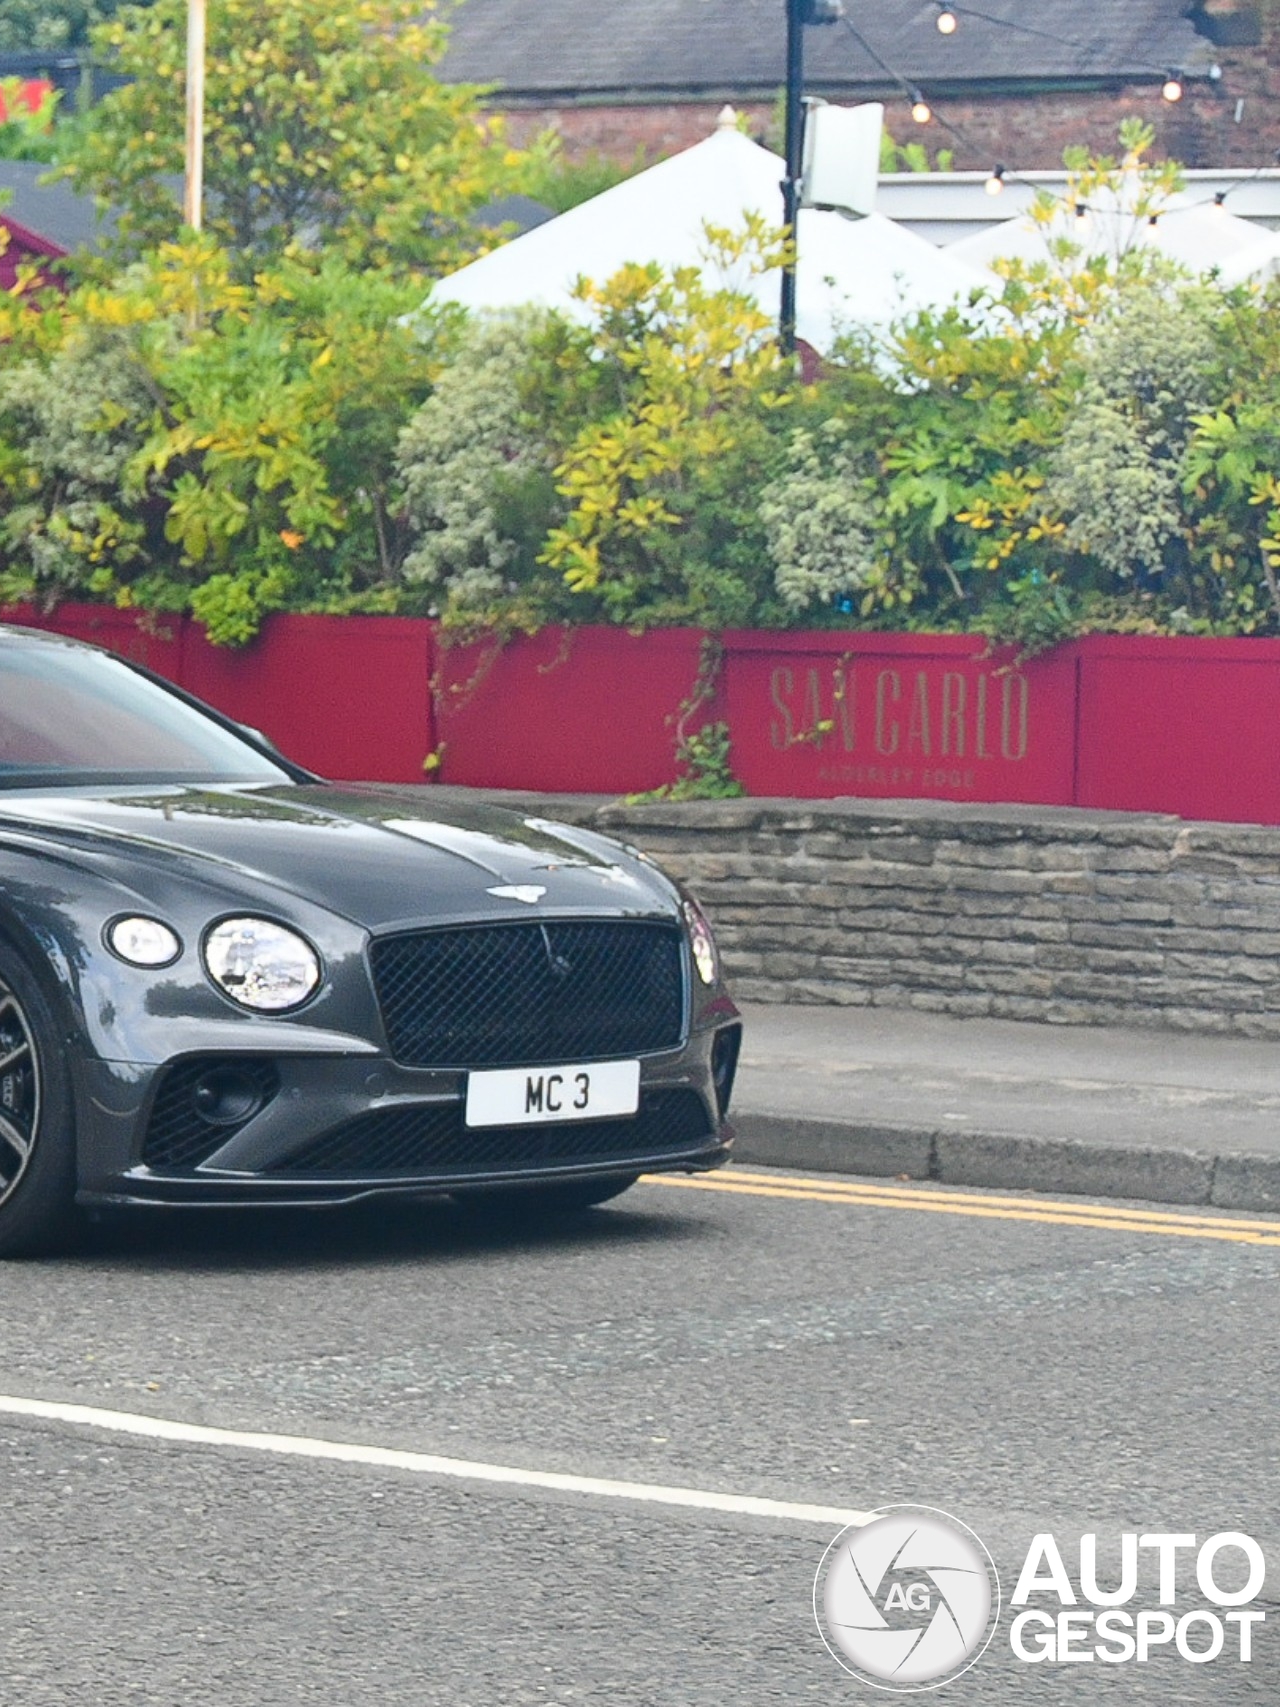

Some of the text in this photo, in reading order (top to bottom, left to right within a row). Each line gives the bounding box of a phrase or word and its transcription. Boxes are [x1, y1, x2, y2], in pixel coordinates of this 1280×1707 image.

[772, 666, 1028, 761] SAN CARLO
[525, 1073, 590, 1113] MC 3
